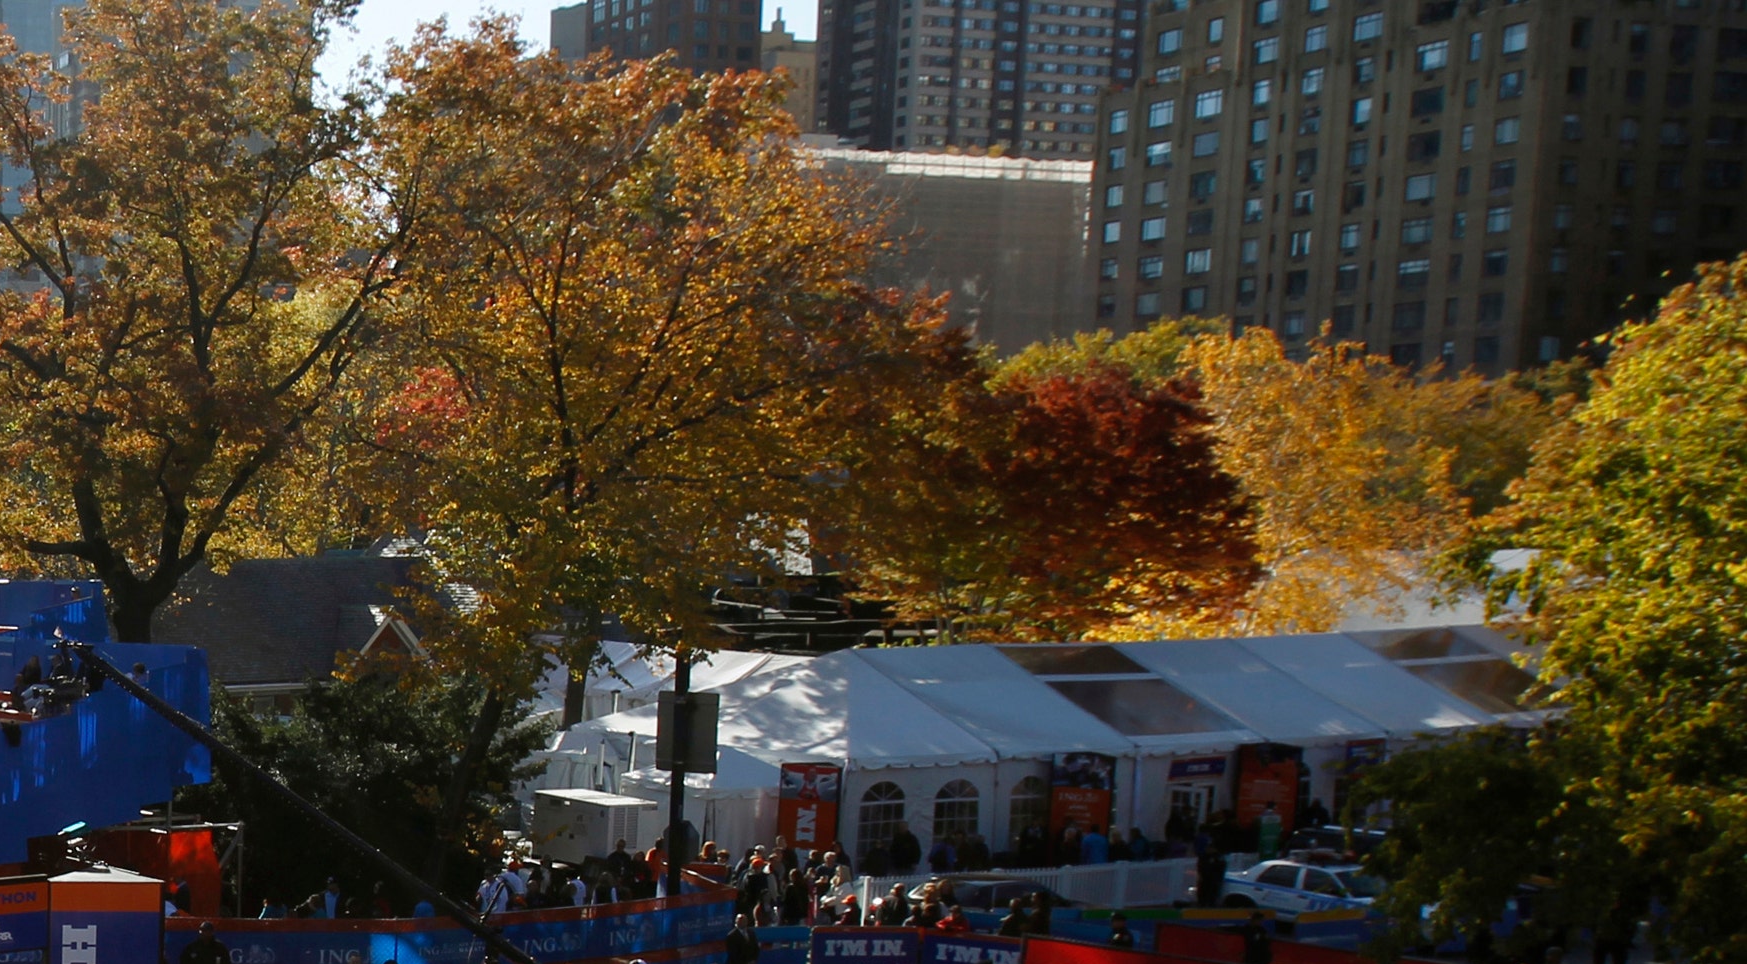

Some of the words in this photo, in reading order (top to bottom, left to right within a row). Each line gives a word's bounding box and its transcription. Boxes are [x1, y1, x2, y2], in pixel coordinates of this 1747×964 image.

[524, 937, 556, 954] ING
[825, 939, 868, 957] I'M
[871, 939, 906, 957] IN.
[936, 943, 982, 964] I'M
